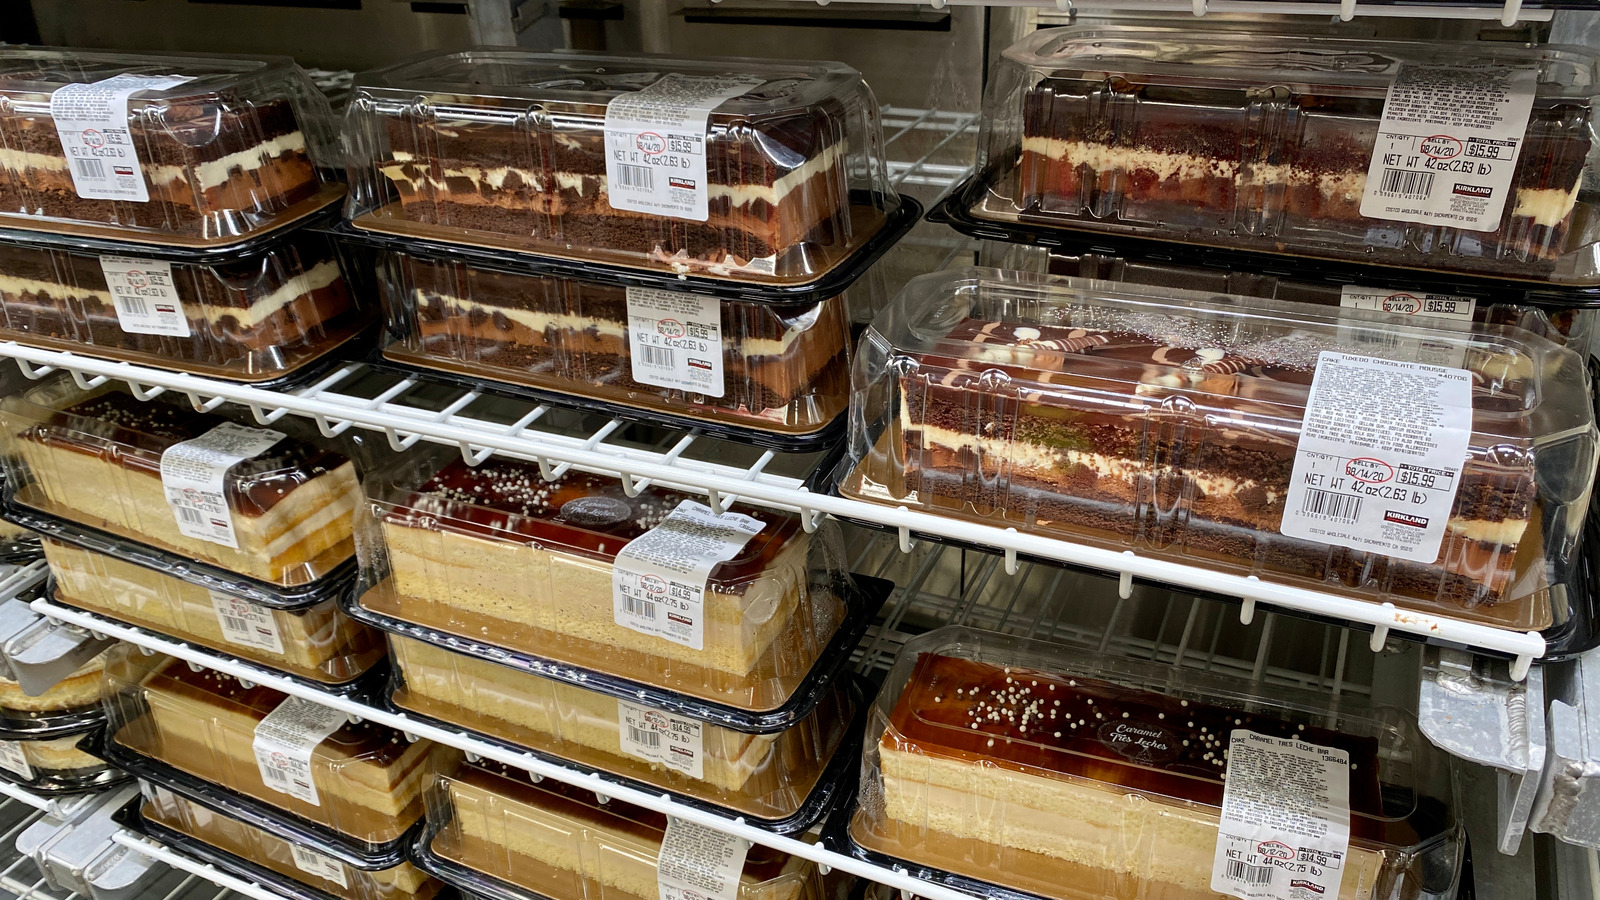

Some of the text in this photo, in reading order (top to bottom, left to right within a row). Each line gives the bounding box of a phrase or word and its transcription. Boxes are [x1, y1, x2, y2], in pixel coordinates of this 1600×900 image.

[670, 140, 691, 152] $15.99
[1420, 145, 1454, 155] 08/14/20
[1467, 144, 1499, 158] $15.99
[613, 149, 625, 160] NET
[630, 151, 638, 162] WT
[643, 153, 650, 164] 42
[1382, 153, 1402, 165] NET
[1406, 156, 1419, 167] WT
[1423, 157, 1437, 169] 42
[1454, 184, 1491, 193] KIRKLAND
[1383, 303, 1413, 312] 08/14/20
[1428, 301, 1456, 312] $15.99
[637, 332, 648, 342] NET
[1341, 354, 1448, 373] TUXEDO CHOCOLATE MOUSSE
[1306, 452, 1332, 460] CNT/QTY
[1304, 472, 1324, 486] NET
[1330, 476, 1344, 489] WT
[1350, 480, 1364, 493] 42
[1345, 466, 1383, 481] 08/14/20
[1400, 470, 1435, 488] $15.99
[1386, 511, 1427, 524] KIRKLAND
[1326, 530, 1350, 539] WHOLESALE
[1363, 538, 1390, 547] SACRAMENTO
[619, 584, 629, 594] NET
[634, 588, 641, 597] WT
[646, 591, 653, 600] 44
[671, 587, 690, 599] $14.99
[625, 716, 635, 725] NET
[1116, 724, 1162, 738] Caramel
[1110, 732, 1168, 750] Tres Leches
[1250, 734, 1274, 746] CARAMEL
[1296, 742, 1314, 752] LECHE
[1317, 746, 1329, 755] BAR
[1225, 848, 1242, 859] NET
[1246, 853, 1258, 863] WT
[1262, 855, 1272, 865] 44
[1300, 852, 1327, 865] $14.99
[1292, 880, 1324, 891] KIRKLAND
